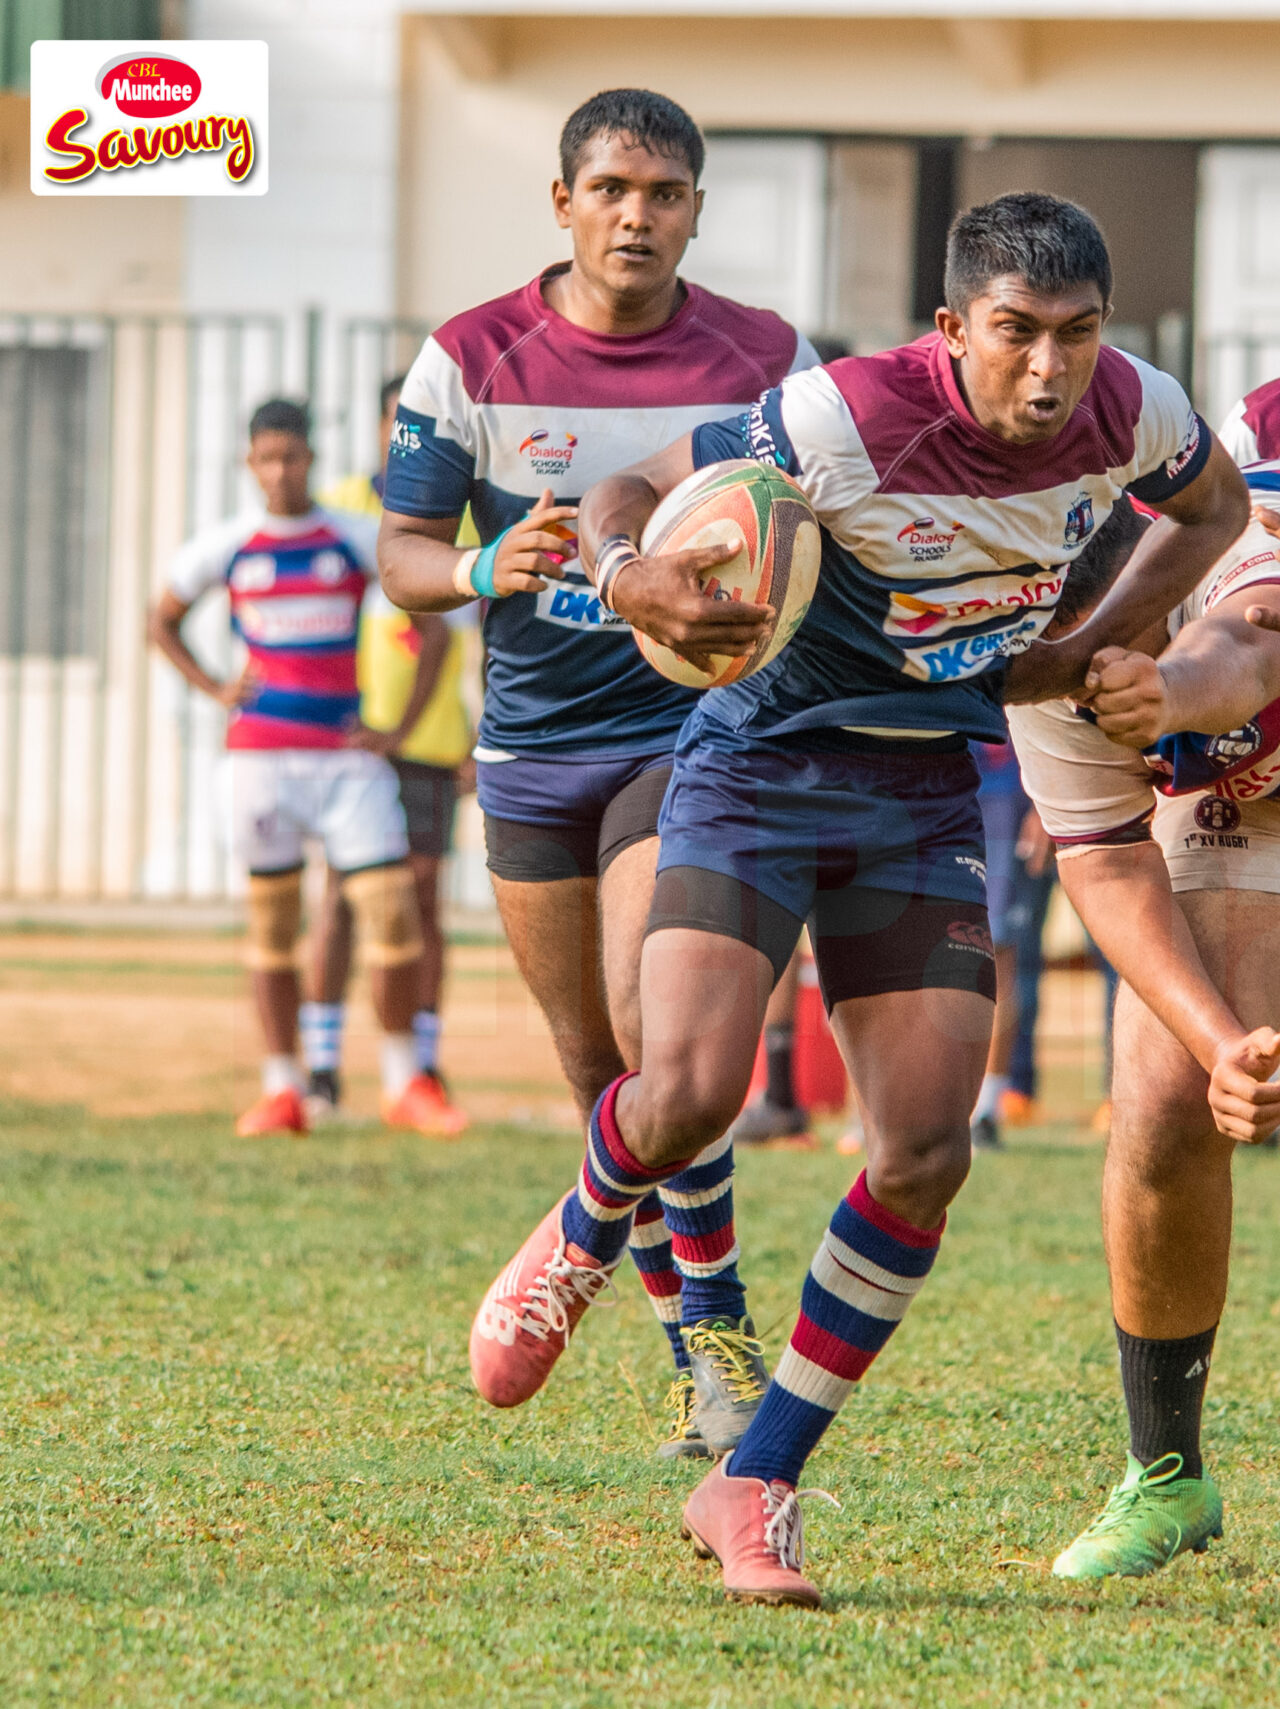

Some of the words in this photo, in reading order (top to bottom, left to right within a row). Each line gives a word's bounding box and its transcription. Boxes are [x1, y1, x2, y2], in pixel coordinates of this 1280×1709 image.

[530, 446, 572, 461] Dialog
[531, 460, 571, 468] SCHOOLS
[910, 532, 955, 545] Dialog
[909, 544, 952, 555] SCHOOLS
[550, 589, 602, 624] DK
[921, 639, 978, 682] DK
[1200, 835, 1214, 847] XV
[1217, 835, 1249, 850] RUGBY
